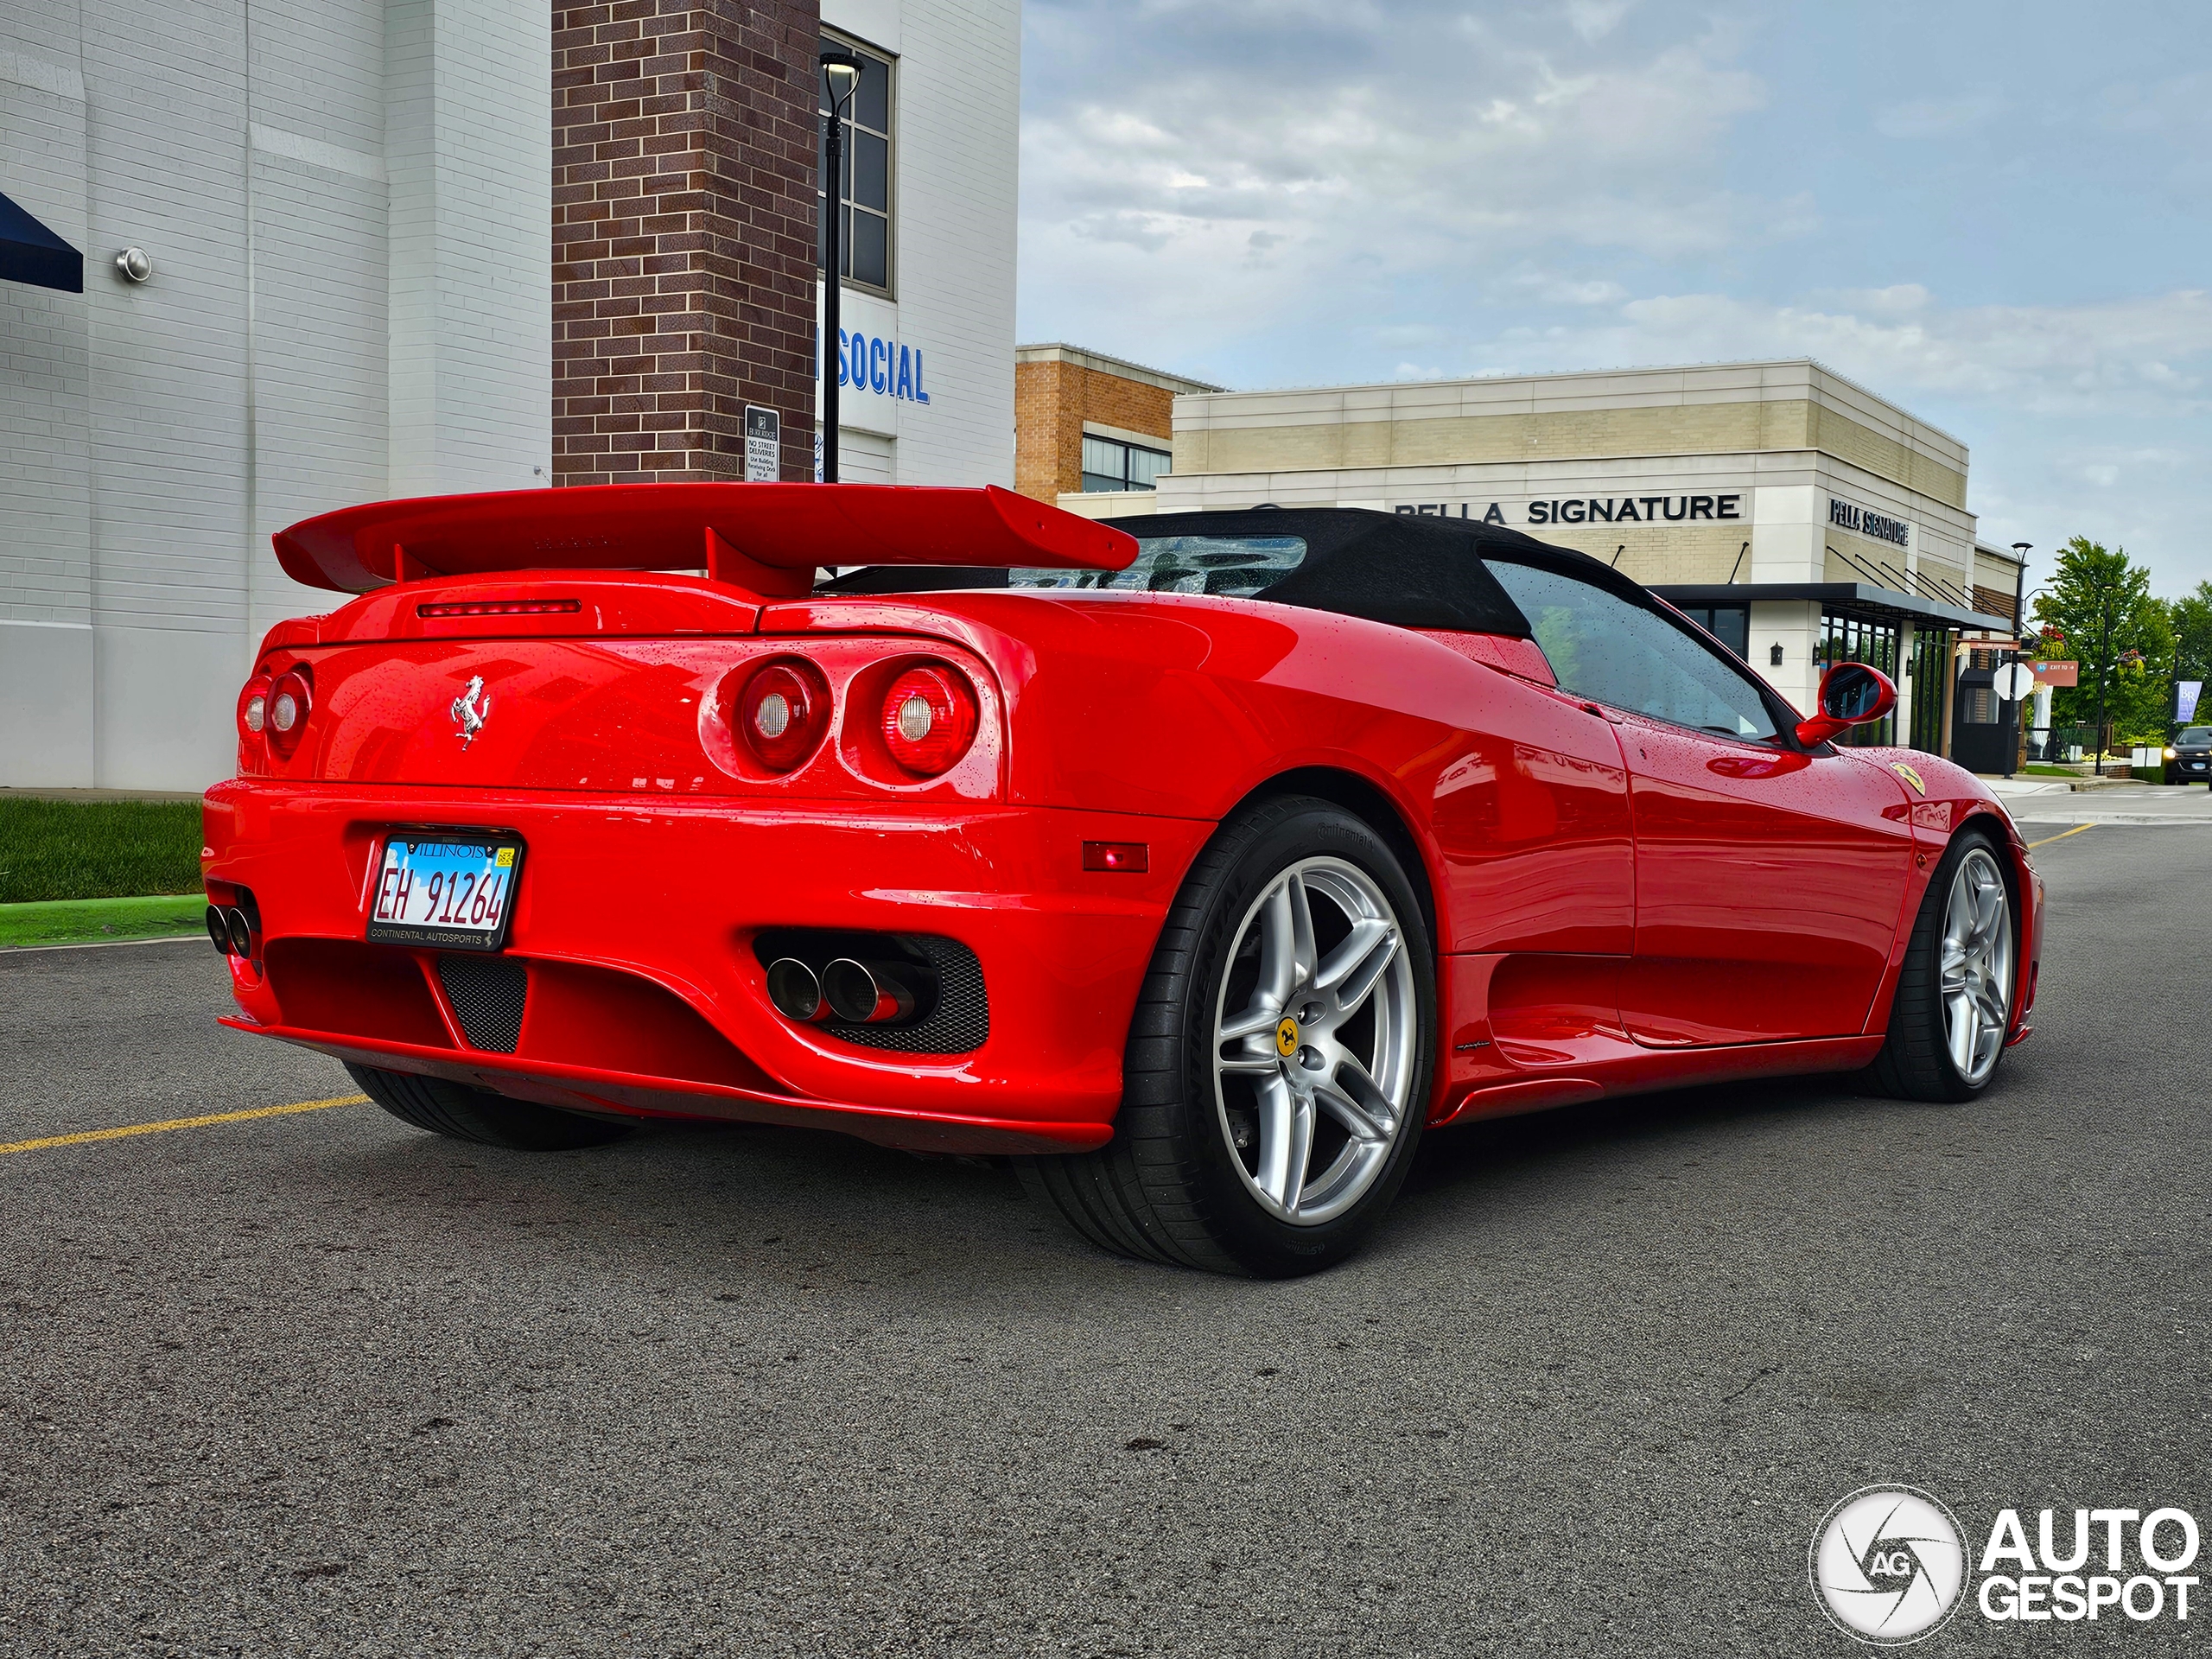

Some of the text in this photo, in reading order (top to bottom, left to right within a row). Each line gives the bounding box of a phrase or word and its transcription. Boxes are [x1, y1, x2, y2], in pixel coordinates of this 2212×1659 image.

[838, 327, 931, 405] SOCIAL
[749, 448, 775, 457] DELIVERIES
[759, 442, 775, 450] STREET
[1528, 494, 1740, 524] SIGNATURE
[1830, 499, 1910, 547] PELLA SIGNATURE
[419, 843, 484, 859] ILLINOIS
[376, 868, 503, 926] EH 91264
[371, 928, 482, 944] CONTINENTAL AUTOSPORTS
